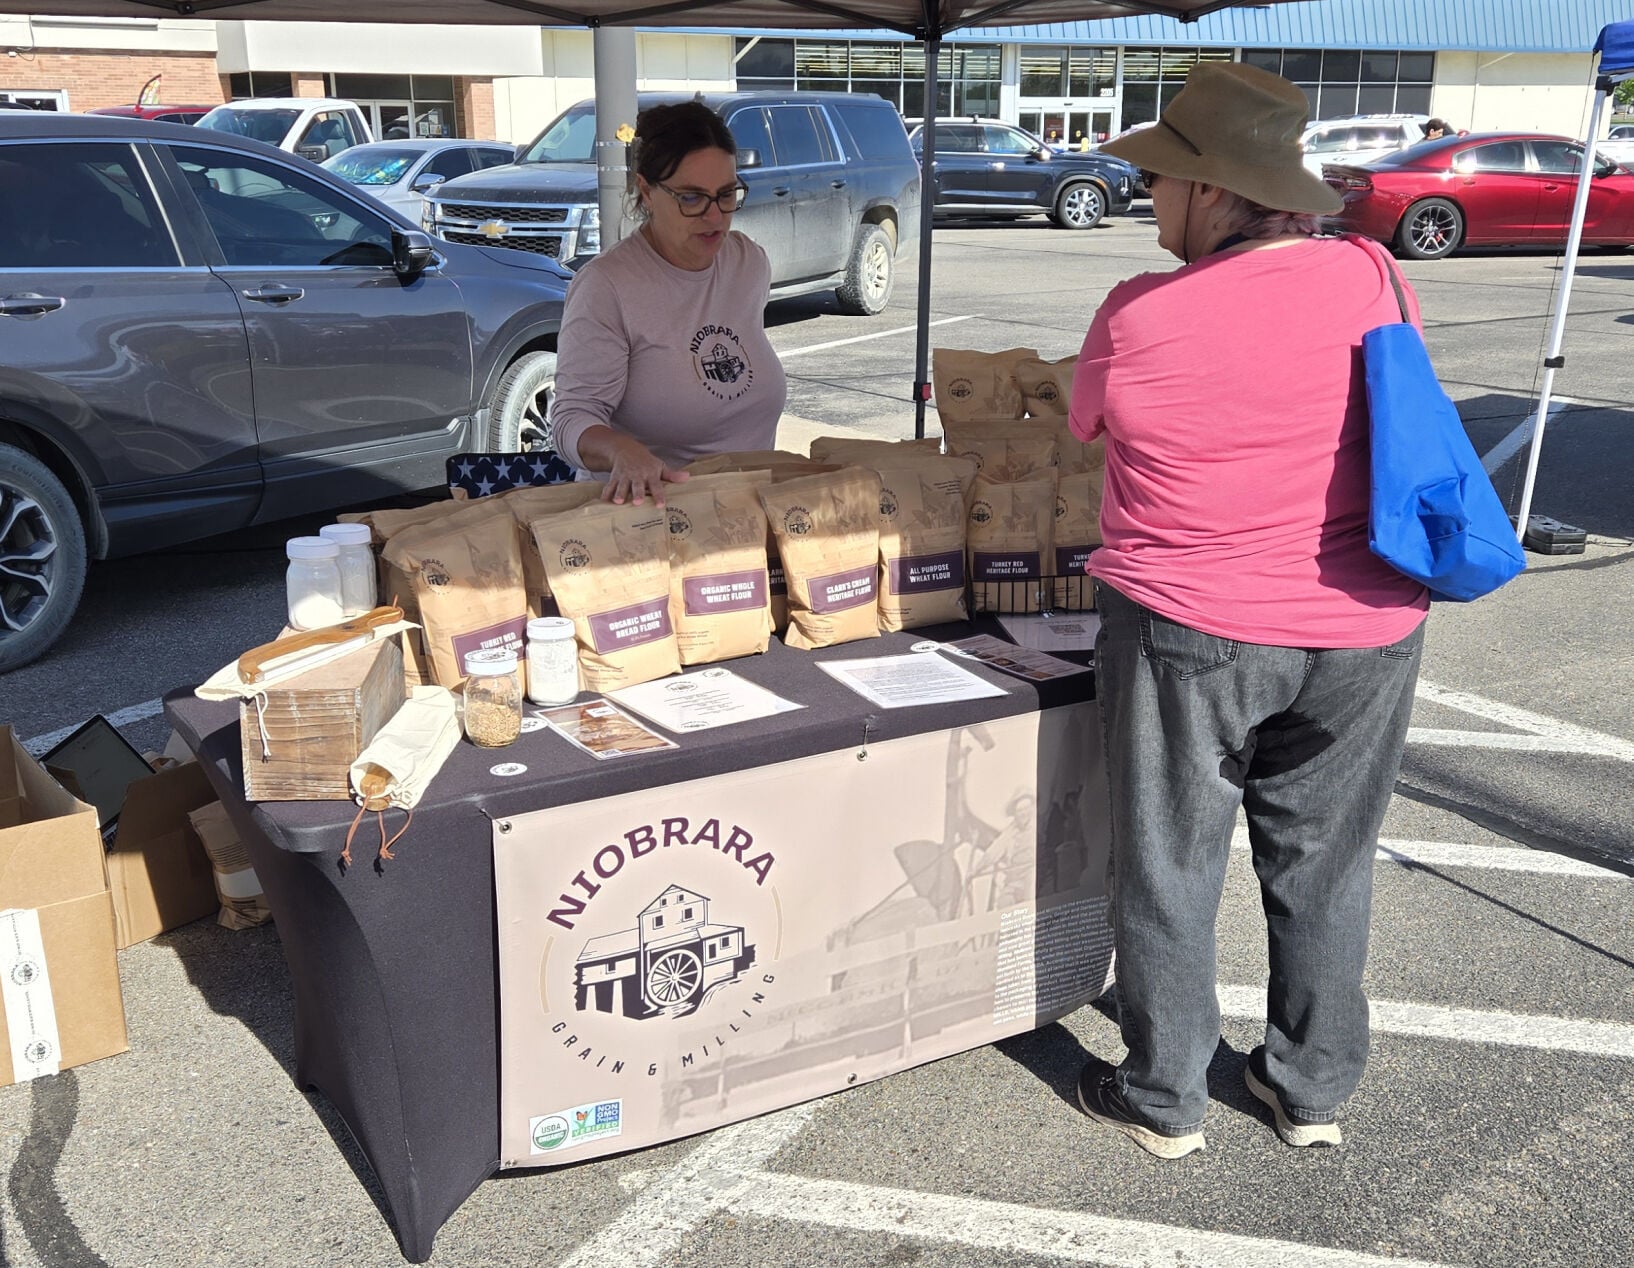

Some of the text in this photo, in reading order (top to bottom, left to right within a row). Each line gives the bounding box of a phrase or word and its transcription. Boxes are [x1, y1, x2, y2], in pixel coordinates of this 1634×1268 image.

[689, 324, 739, 355] NIOBRARA
[909, 563, 950, 575] ALL PURPOSE
[909, 571, 951, 583] WHEAT FLOUR
[700, 581, 755, 595] ORGANIC WHOLE
[826, 577, 871, 594] CLARK'S CREAM
[706, 591, 752, 604] WHEAT FLOUR
[827, 585, 872, 603] HERITAGE FLOUR
[608, 610, 662, 631] ORGANIC WHEAT
[615, 626, 639, 639] BREAD
[639, 620, 661, 632] FLOUR
[480, 635, 503, 649] TURKEY
[503, 632, 517, 643] RED
[545, 816, 776, 931] NIOBRARA
[551, 1021, 625, 1075] GRAIN
[647, 1063, 658, 1076] &
[681, 972, 776, 1069] MILLING
[596, 1109, 618, 1119] GMO
[597, 1103, 618, 1113] NON
[541, 1123, 562, 1134] USDA
[573, 1121, 618, 1137] VERIFIED
